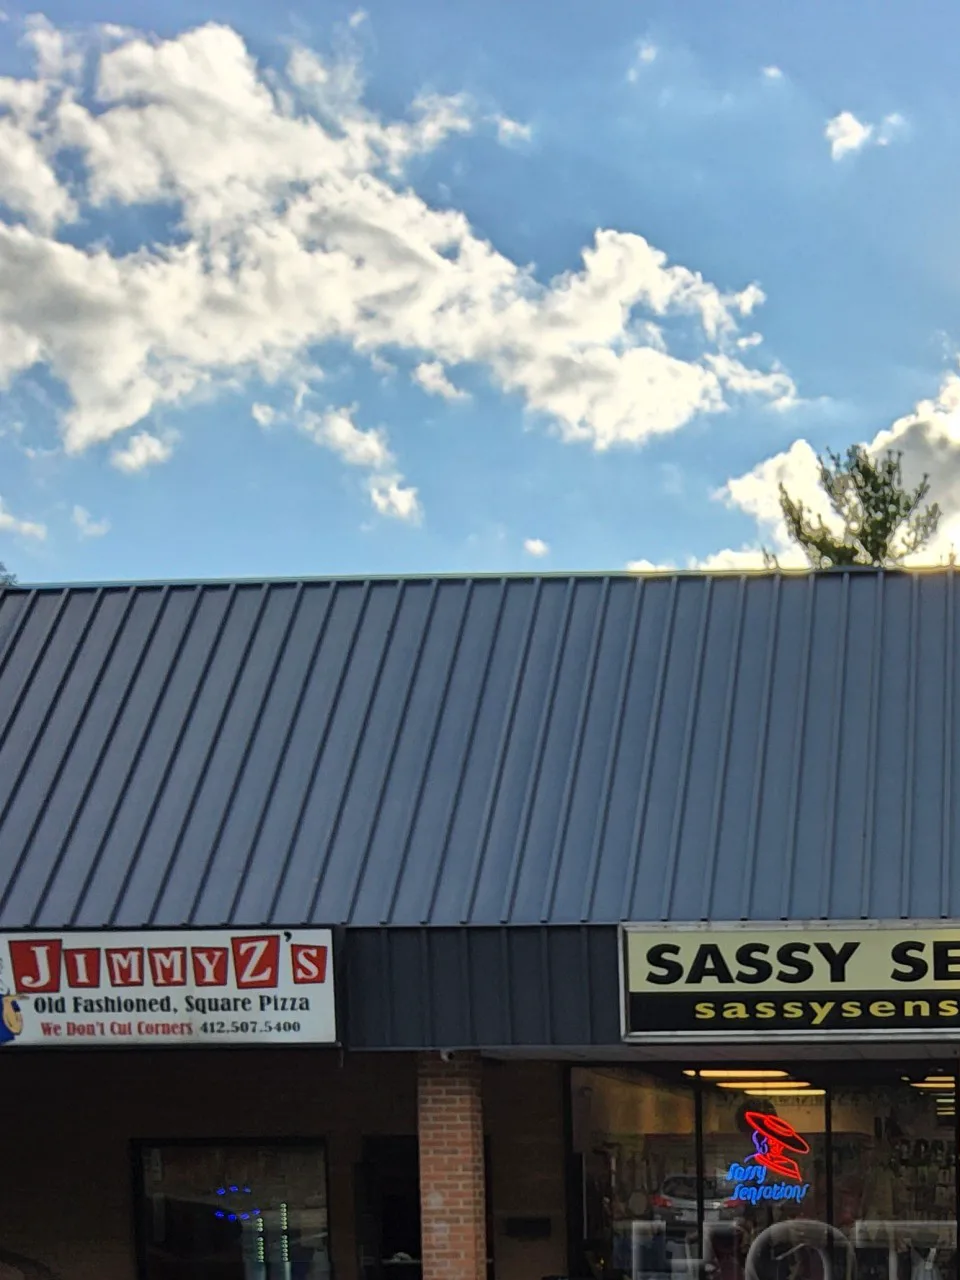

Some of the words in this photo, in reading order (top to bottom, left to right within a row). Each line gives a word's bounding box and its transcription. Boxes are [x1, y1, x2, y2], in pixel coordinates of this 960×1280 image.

[645, 941, 861, 985] SASSY
[34, 997, 66, 1013] Old
[72, 996, 178, 1014] Fashioned,
[185, 995, 251, 1014] Square
[259, 995, 310, 1011] Pizza
[40, 1021, 61, 1036] We
[66, 1021, 105, 1036] Don't
[110, 1021, 132, 1036] Cut
[137, 1020, 193, 1036] Corners
[200, 1020, 301, 1034] 412.507.5400
[726, 1163, 767, 1184] Sassy
[731, 1182, 810, 1205] Sensations
